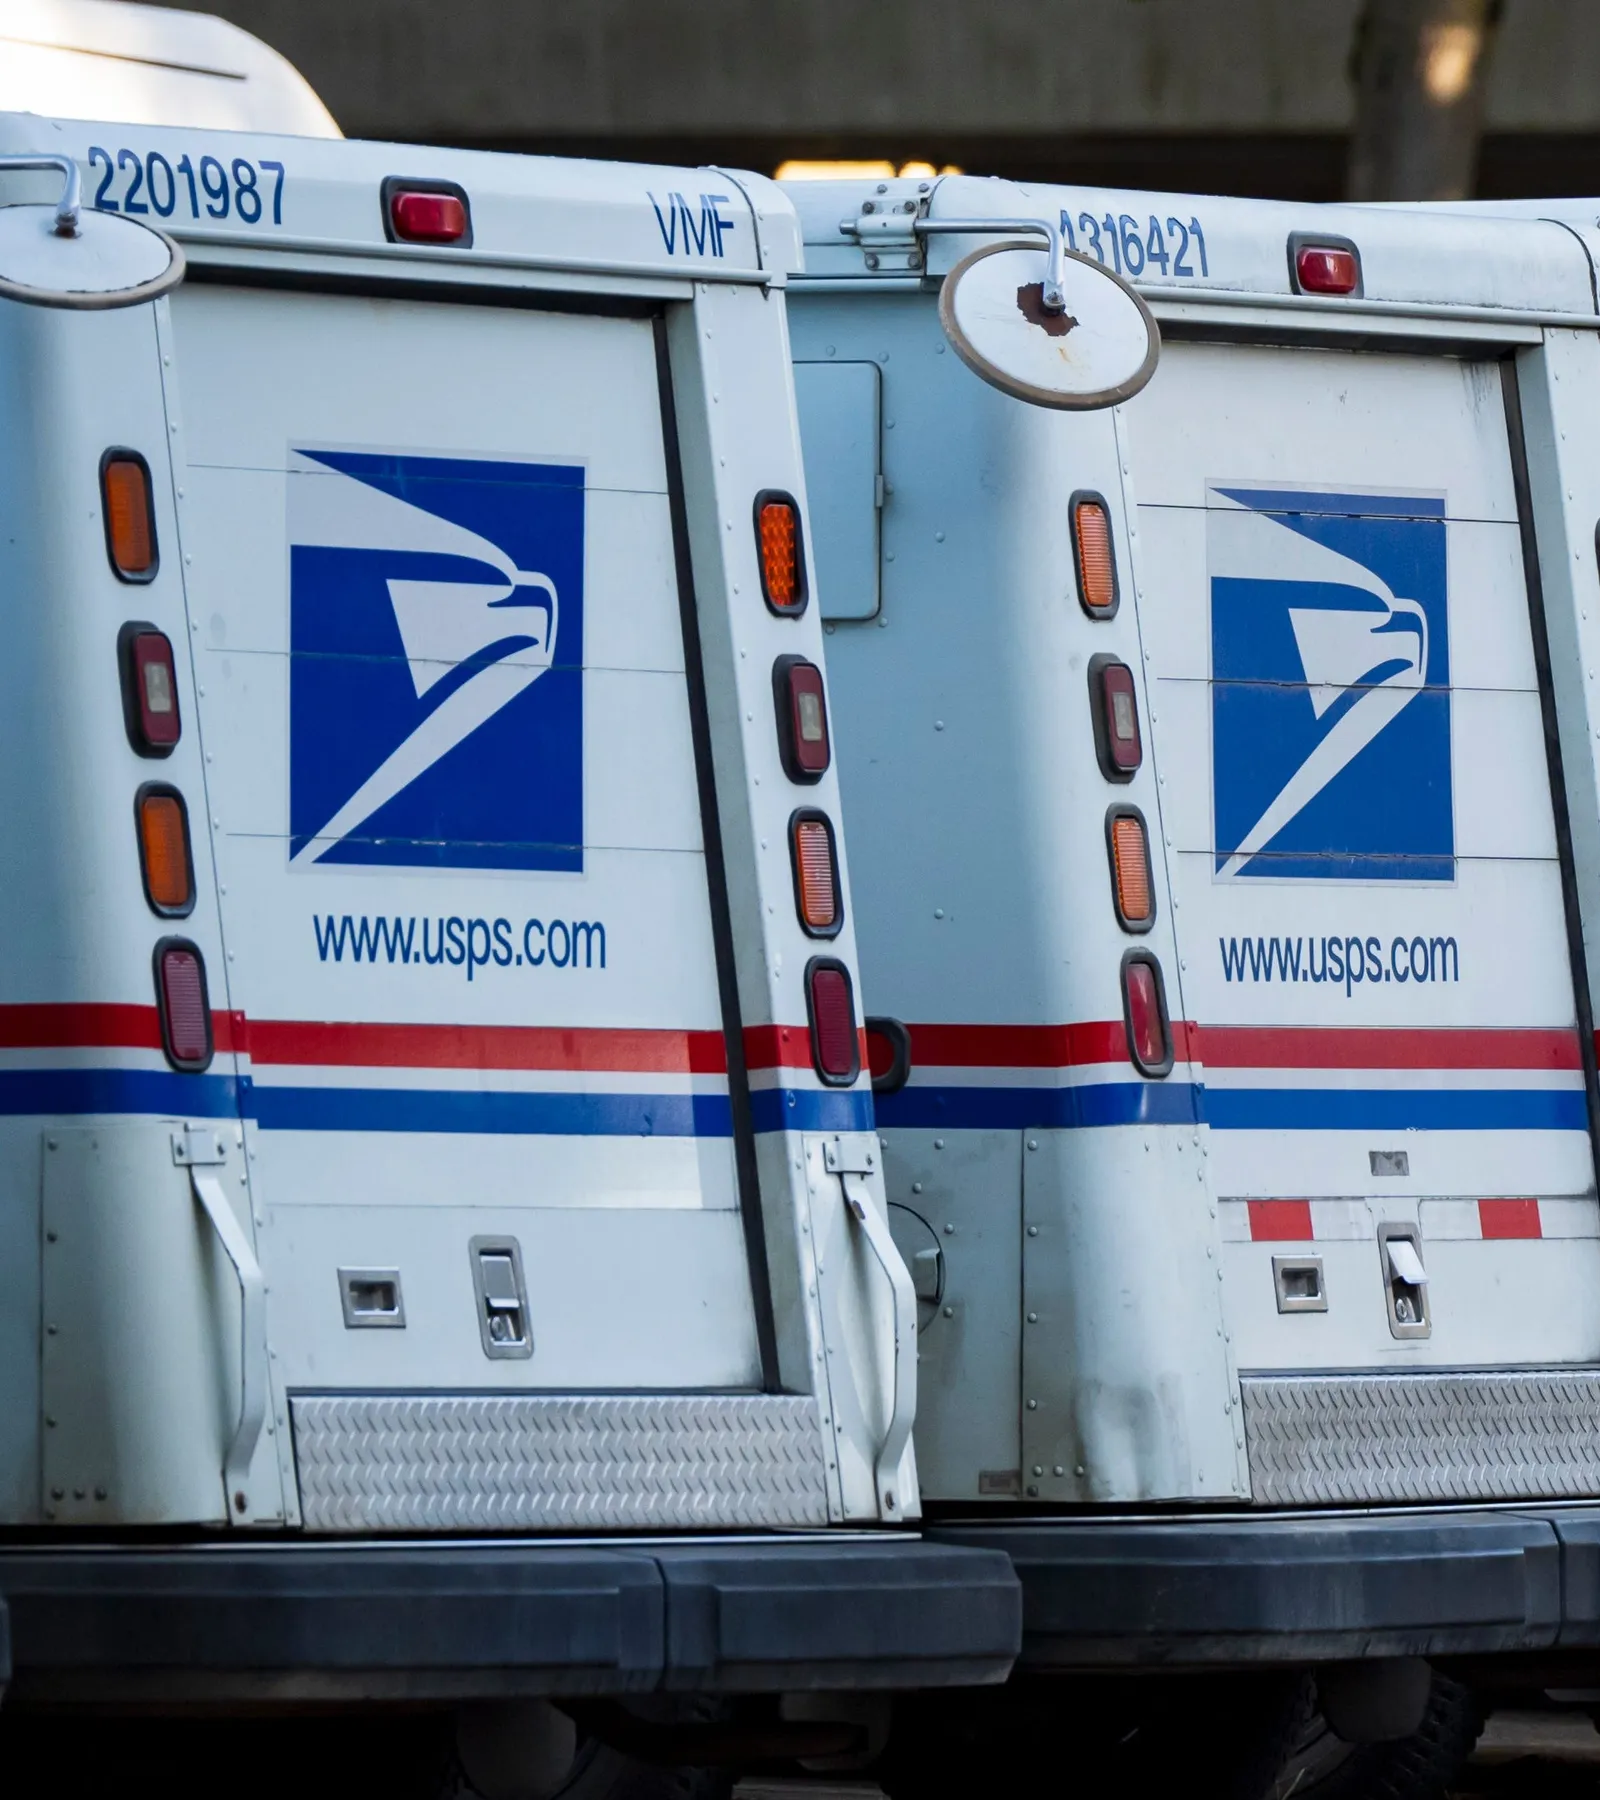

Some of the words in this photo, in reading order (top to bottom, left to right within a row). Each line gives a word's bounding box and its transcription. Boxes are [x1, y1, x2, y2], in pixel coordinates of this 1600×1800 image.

[88, 146, 285, 225] 2201987
[646, 191, 734, 257] VMF
[313, 914, 606, 981] www.usps.com
[1219, 936, 1459, 998] www.usps.com
